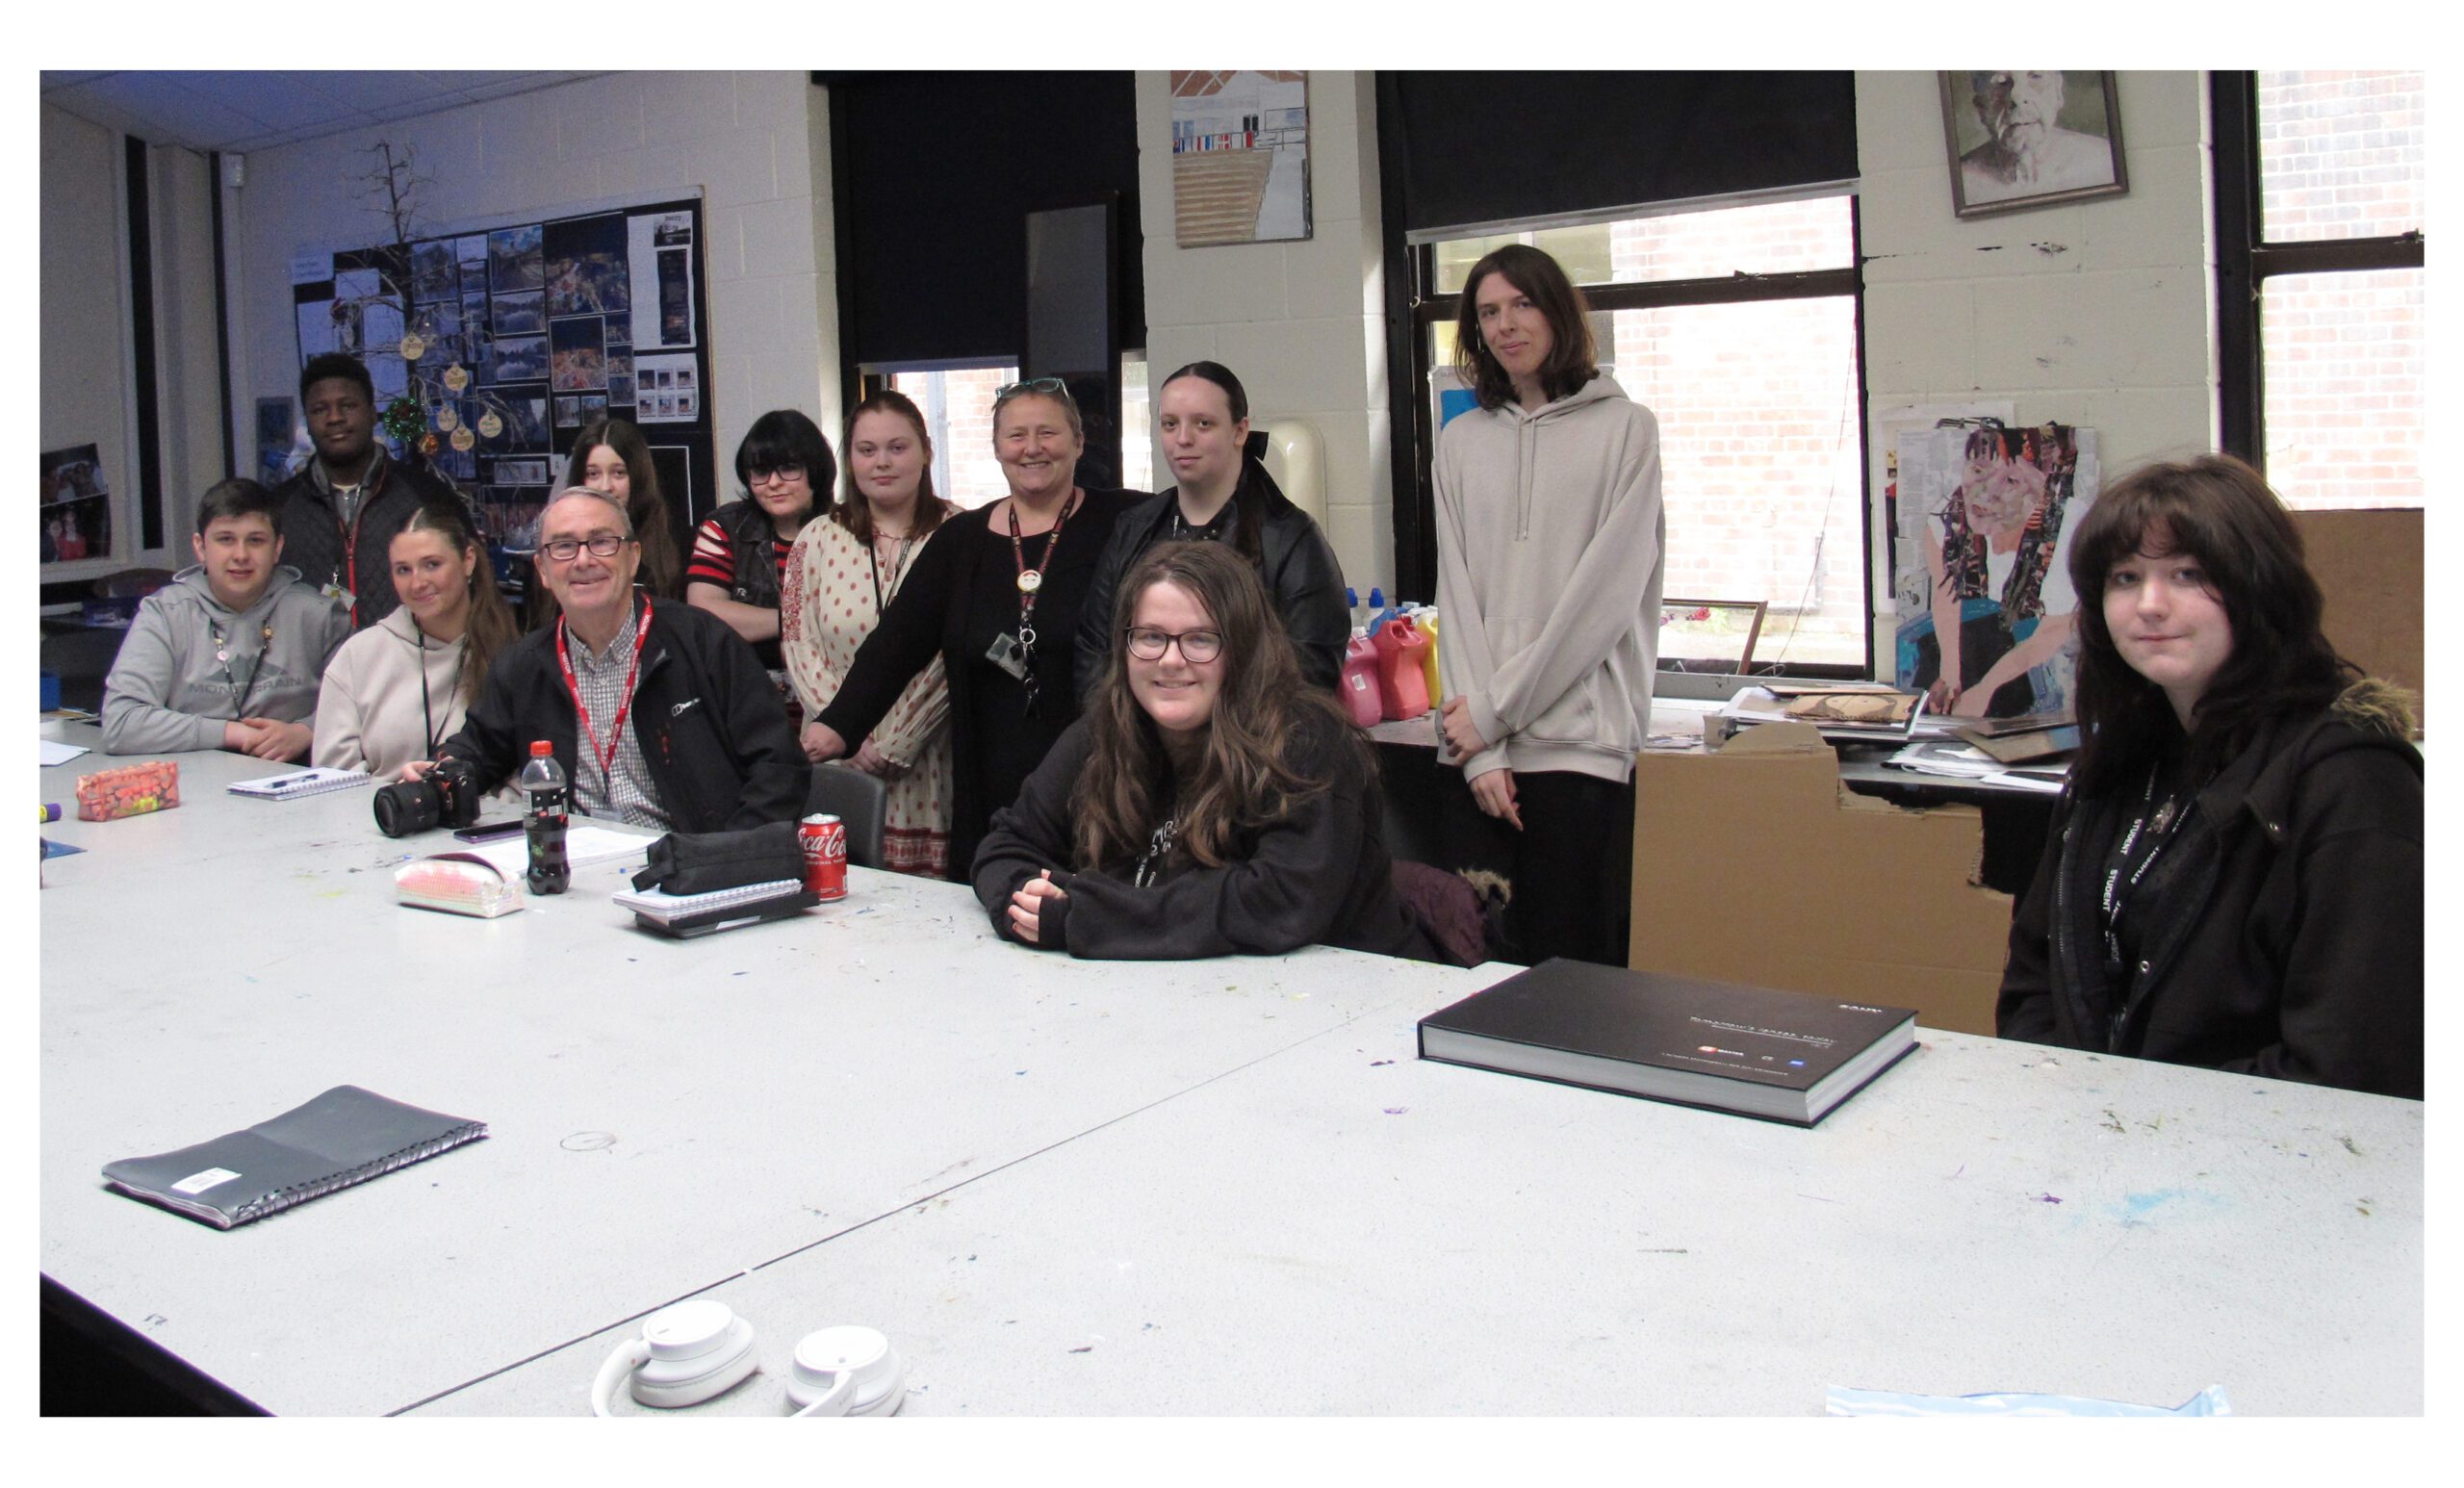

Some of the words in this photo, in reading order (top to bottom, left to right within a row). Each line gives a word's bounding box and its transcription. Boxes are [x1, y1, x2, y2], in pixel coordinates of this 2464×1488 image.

[2119, 819, 2143, 855] STUDENT
[2130, 845, 2160, 884] STUDENT
[2103, 869, 2118, 911] STUDENT
